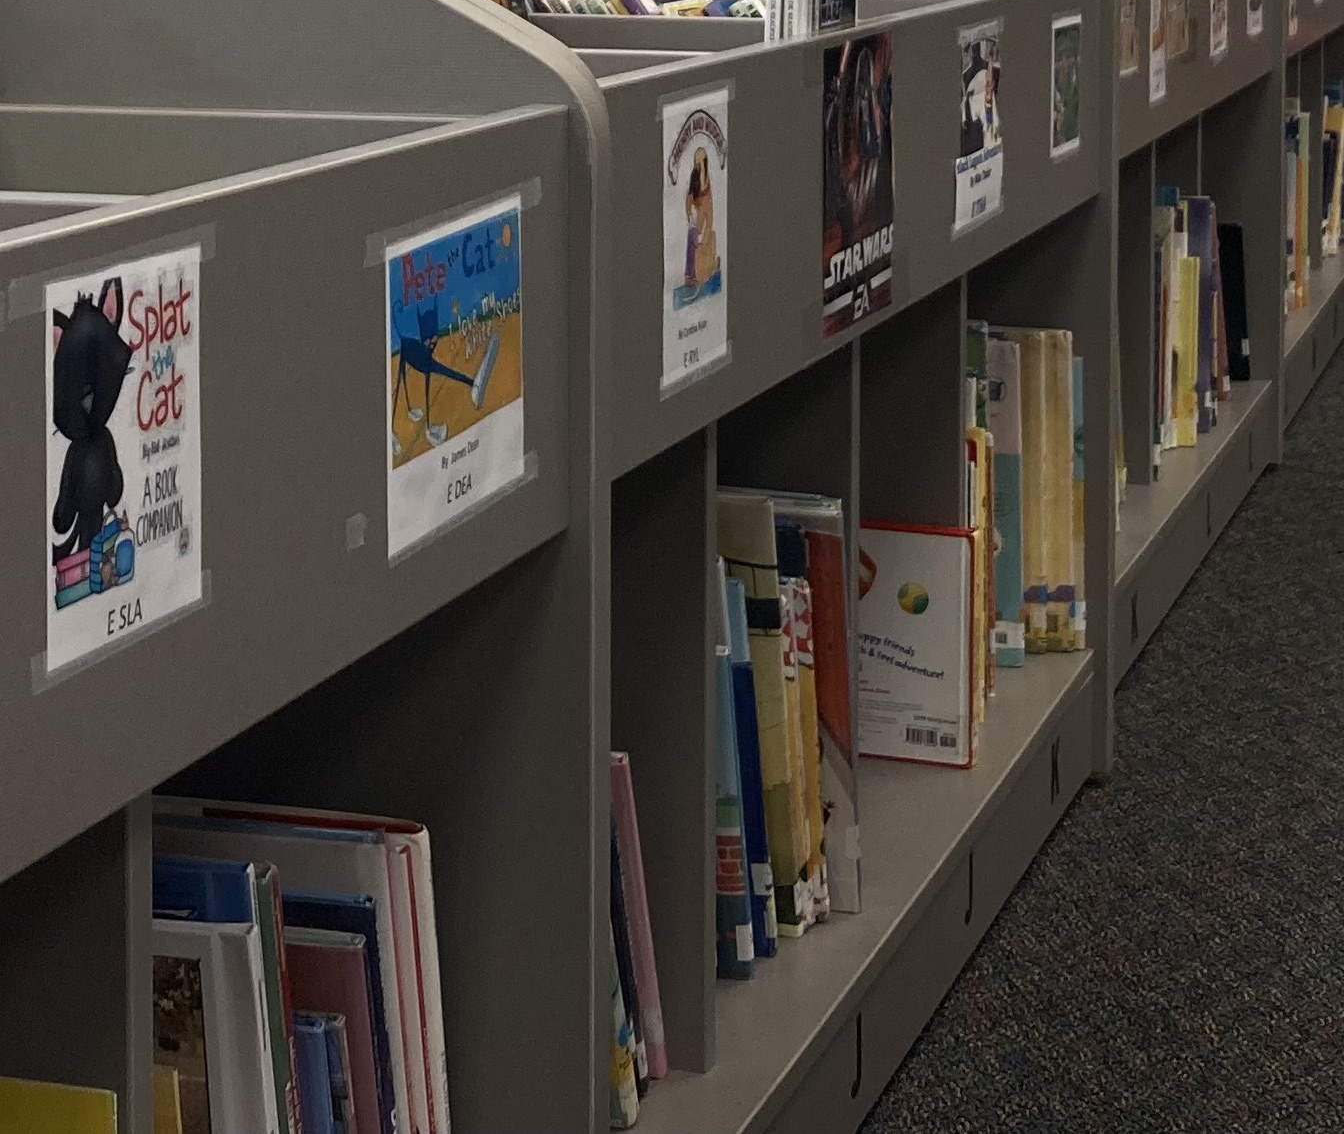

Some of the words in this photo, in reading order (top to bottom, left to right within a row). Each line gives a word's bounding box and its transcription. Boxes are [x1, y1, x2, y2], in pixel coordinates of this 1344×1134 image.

[400, 252, 448, 307] Pete
[461, 226, 496, 279] Cat
[824, 242, 863, 290] STAR
[862, 223, 894, 268] WARS
[127, 277, 193, 361] Splat
[852, 283, 870, 320] EA
[135, 363, 184, 432] Cat
[142, 474, 153, 509] A
[154, 466, 179, 504] BOOK
[447, 482, 454, 505] E
[455, 472, 474, 501] DEA
[106, 609, 115, 637] E
[117, 597, 143, 631] SLA
